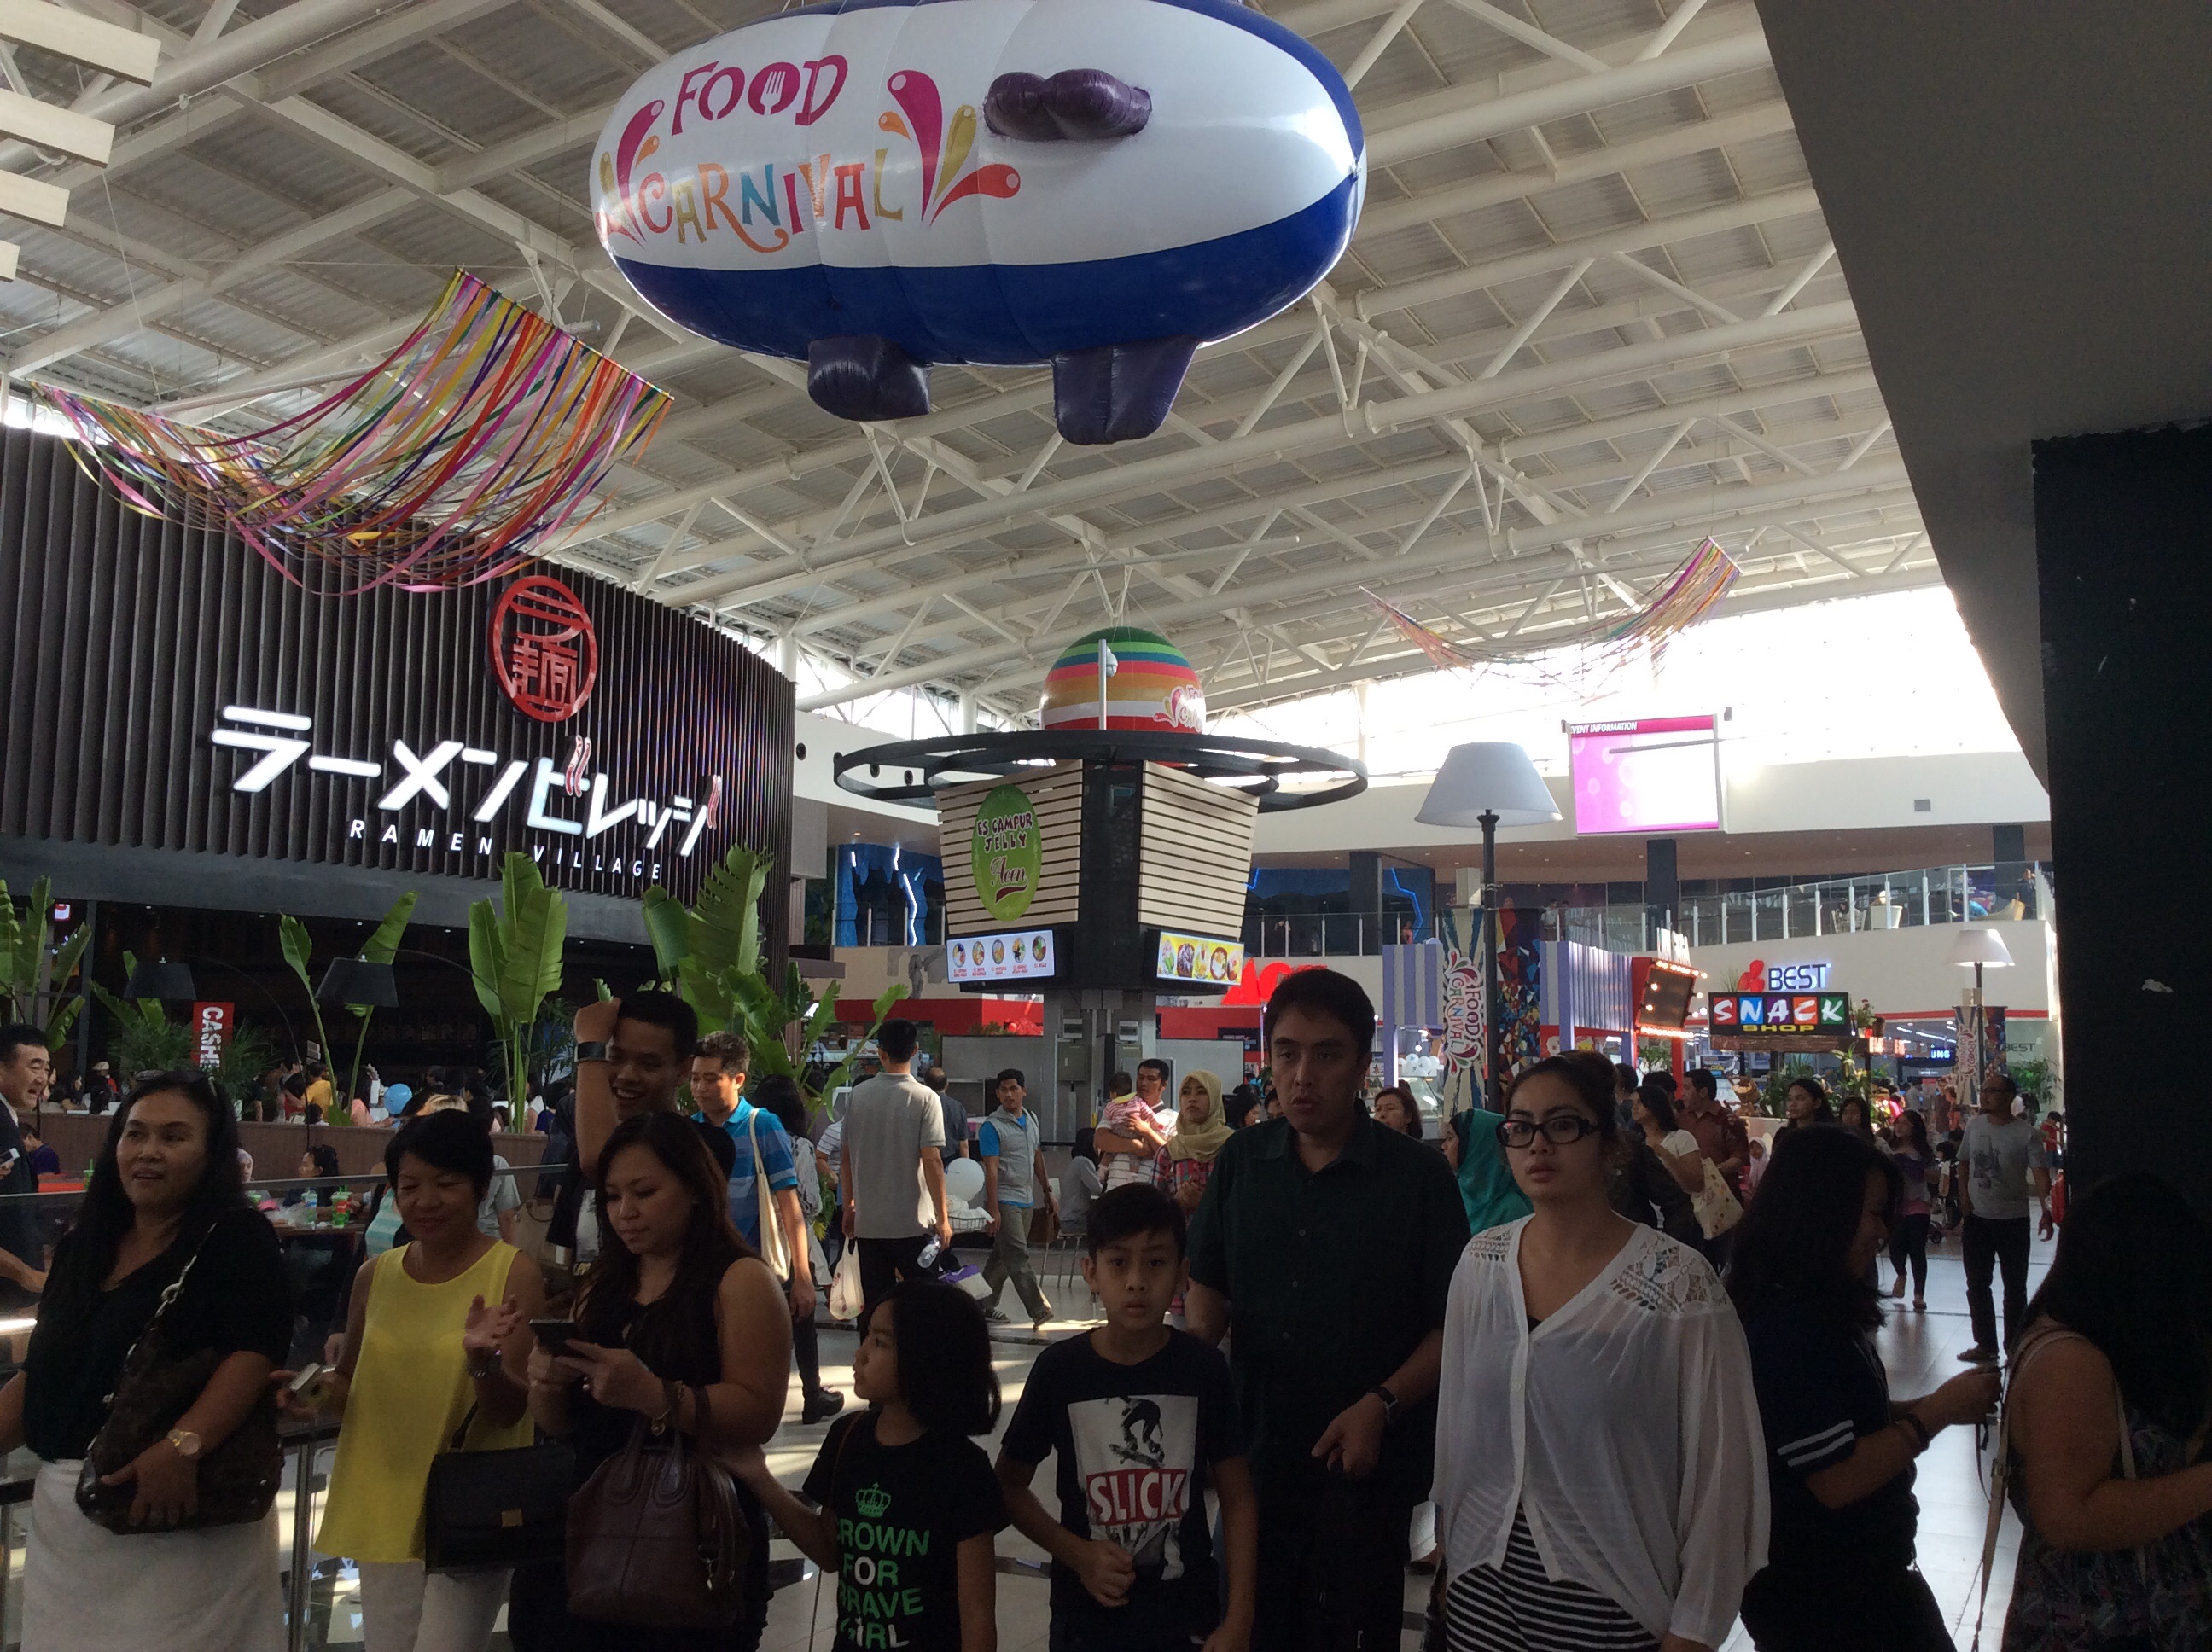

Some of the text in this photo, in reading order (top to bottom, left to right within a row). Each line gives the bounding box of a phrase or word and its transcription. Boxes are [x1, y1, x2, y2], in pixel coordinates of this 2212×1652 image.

[672, 55, 848, 136] FOOD
[638, 148, 903, 253] CARNIVAL
[977, 811, 1033, 836] ES CAMPUR
[984, 831, 1027, 853] JELLY
[350, 819, 662, 880] RAMEN VILLAGE
[1768, 963, 1828, 991] BEST
[1447, 977, 1465, 1049] CARNIVAL
[1464, 989, 1482, 1037] FOOD
[1714, 998, 1844, 1024] SNACK
[1743, 1024, 1815, 1032] SHOP
[1089, 1470, 1185, 1523] SLICK
[838, 1517, 930, 1557] ROWN
[842, 1551, 899, 1588] FOR
